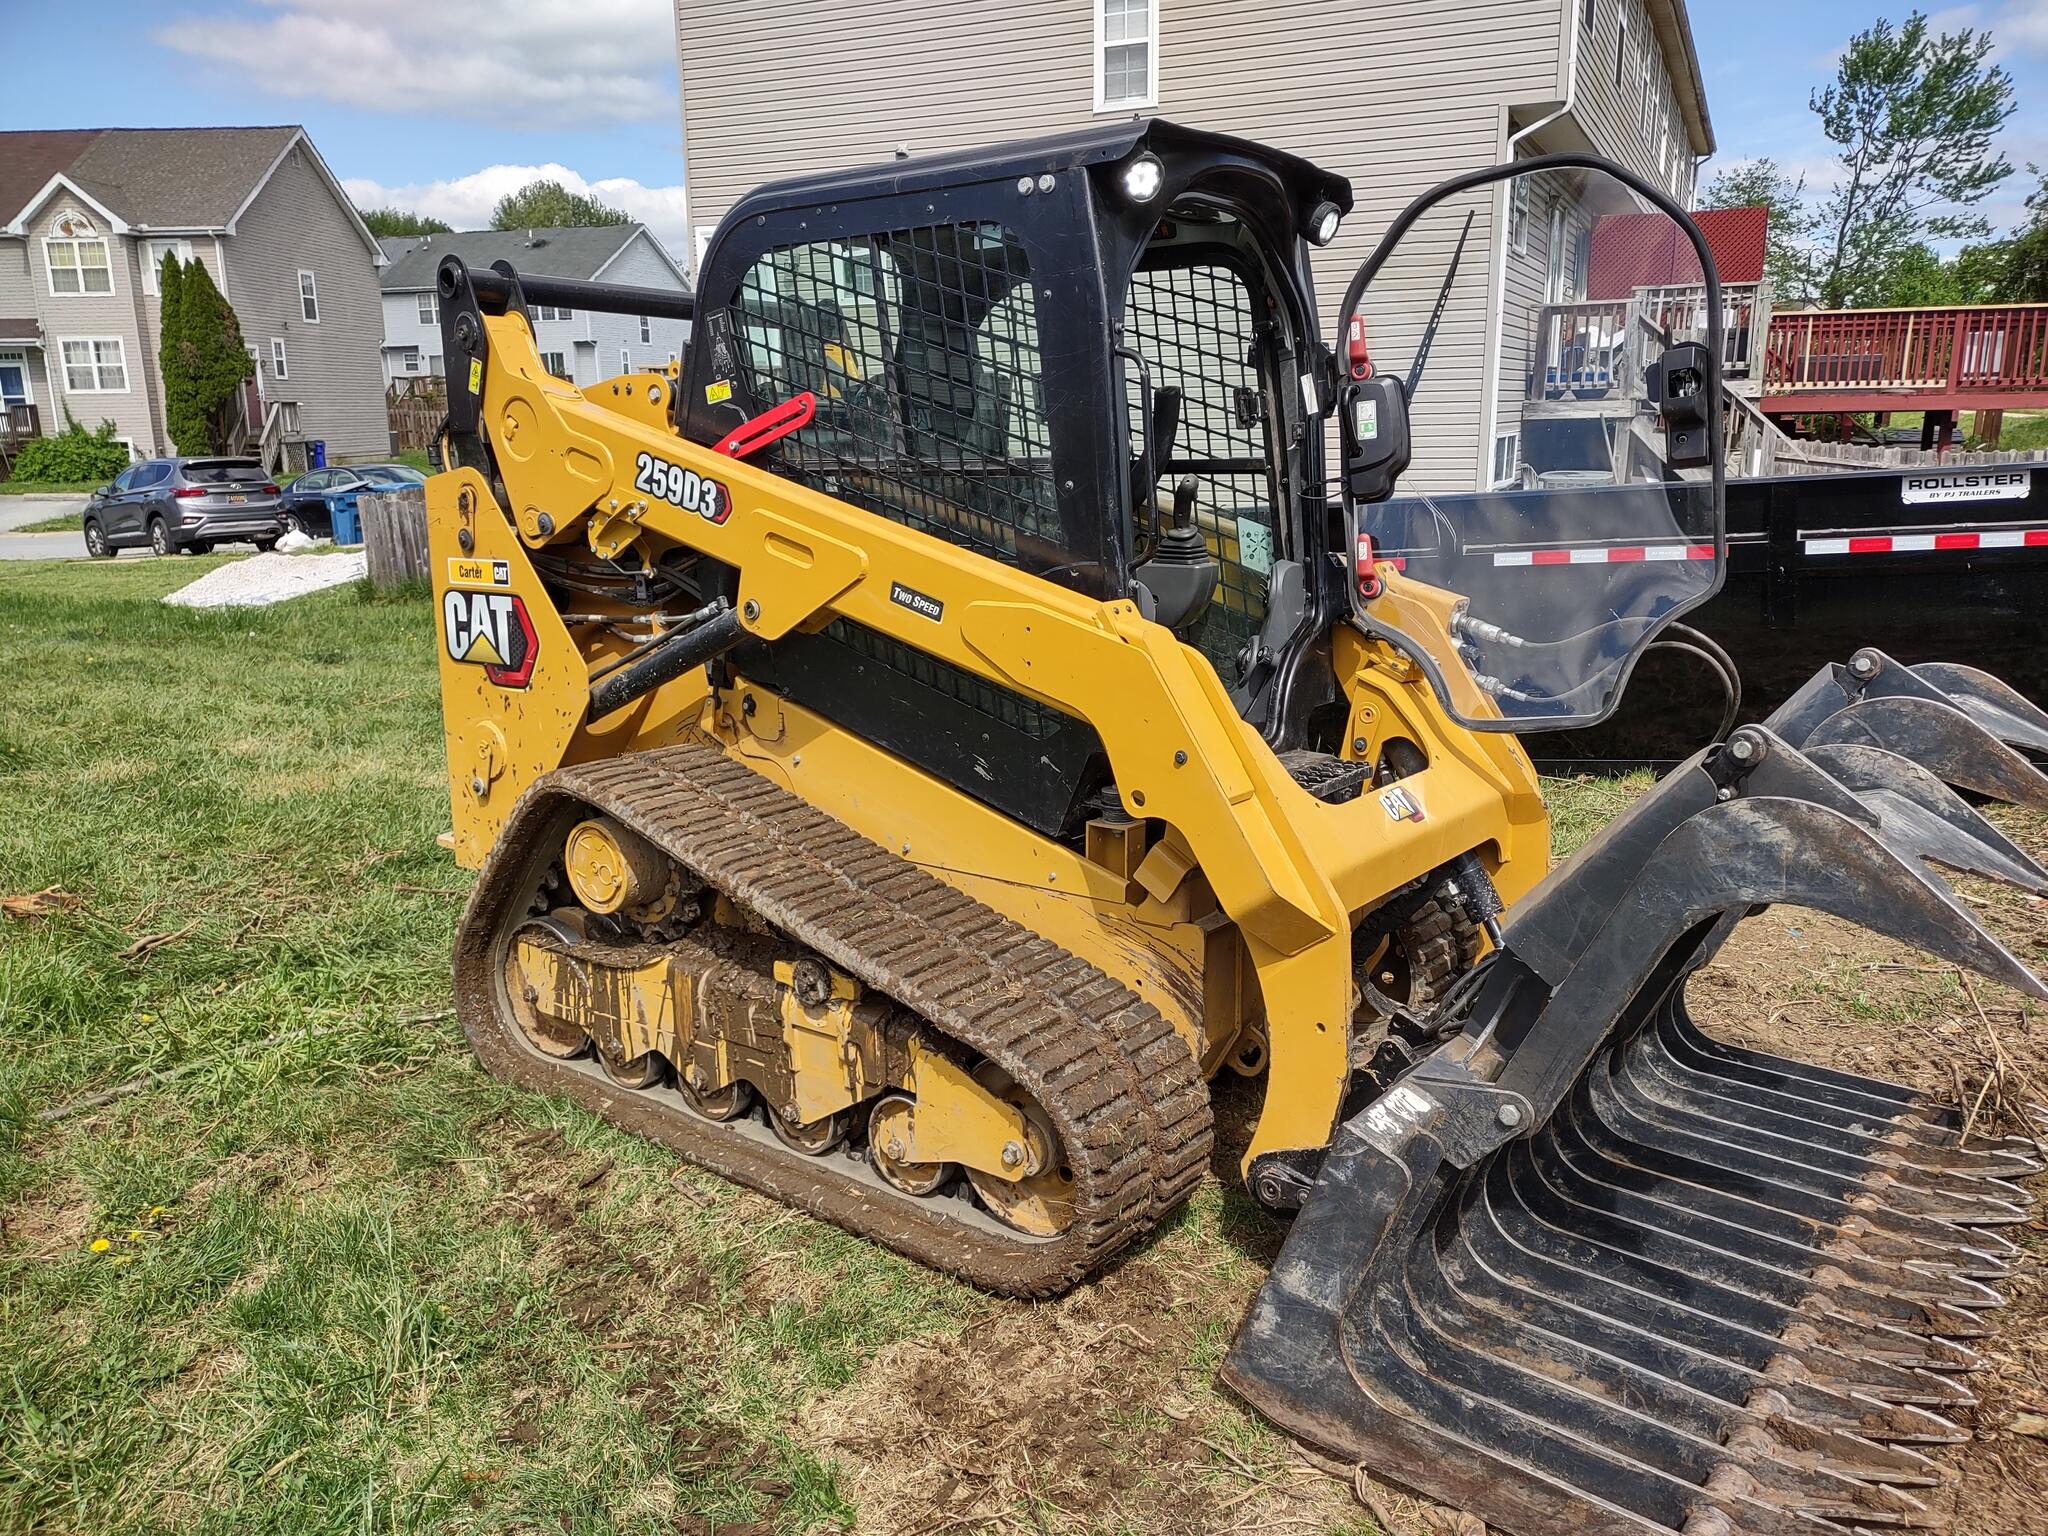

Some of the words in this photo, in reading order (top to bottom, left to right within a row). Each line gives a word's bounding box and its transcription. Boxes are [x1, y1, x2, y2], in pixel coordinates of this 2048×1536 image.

[635, 451, 718, 519] 259D3
[1908, 474, 2024, 490] ROLLSTER
[1929, 491, 1941, 499] BY
[1944, 490, 1955, 498] PJ
[1958, 489, 2001, 497] TRAILERS
[458, 564, 482, 579] Carter
[493, 566, 508, 581] CAT
[893, 586, 912, 604] TWO
[912, 595, 940, 616] SPEED
[444, 591, 513, 666] CAT
[1378, 786, 1417, 822] CAT
